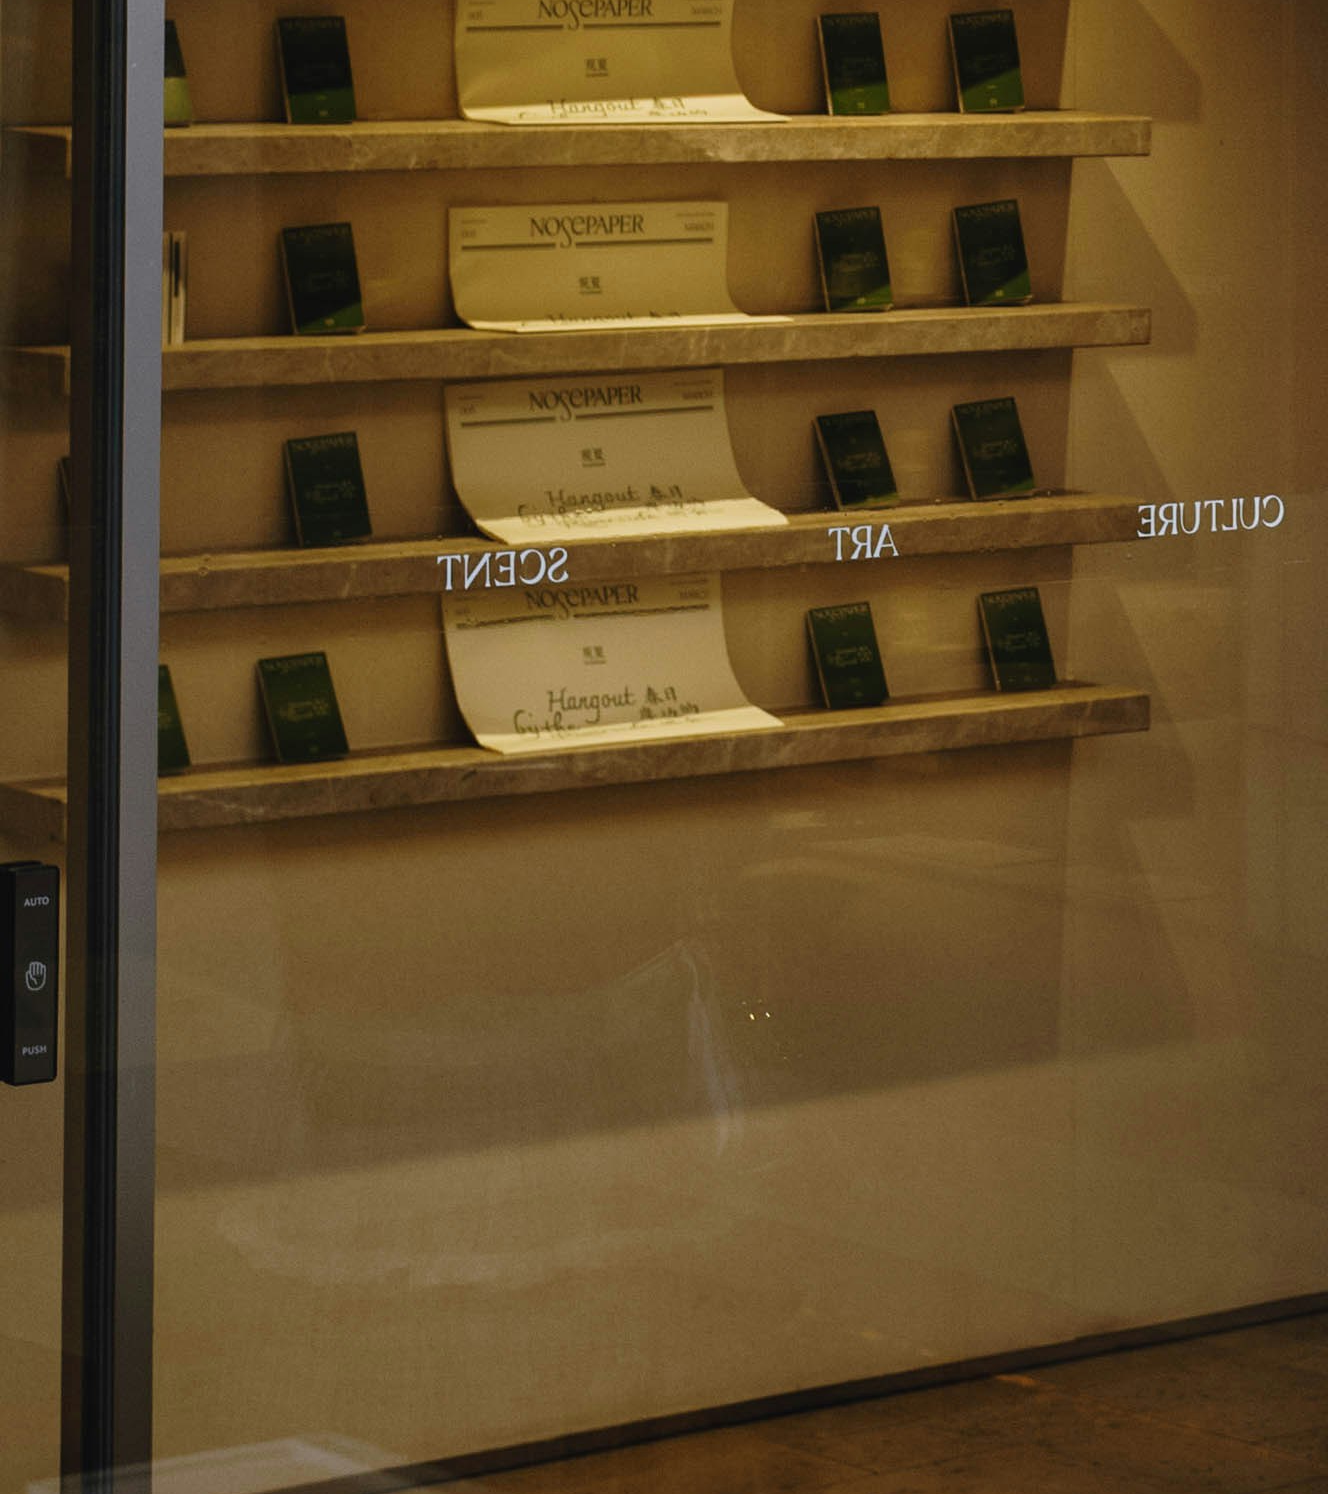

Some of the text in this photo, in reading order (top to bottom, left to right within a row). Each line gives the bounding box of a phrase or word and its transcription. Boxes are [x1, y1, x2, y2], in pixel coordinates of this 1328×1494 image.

[546, 685, 637, 724] Hangout
[23, 895, 50, 908] AUTO
[21, 1043, 48, 1056] PUSH
